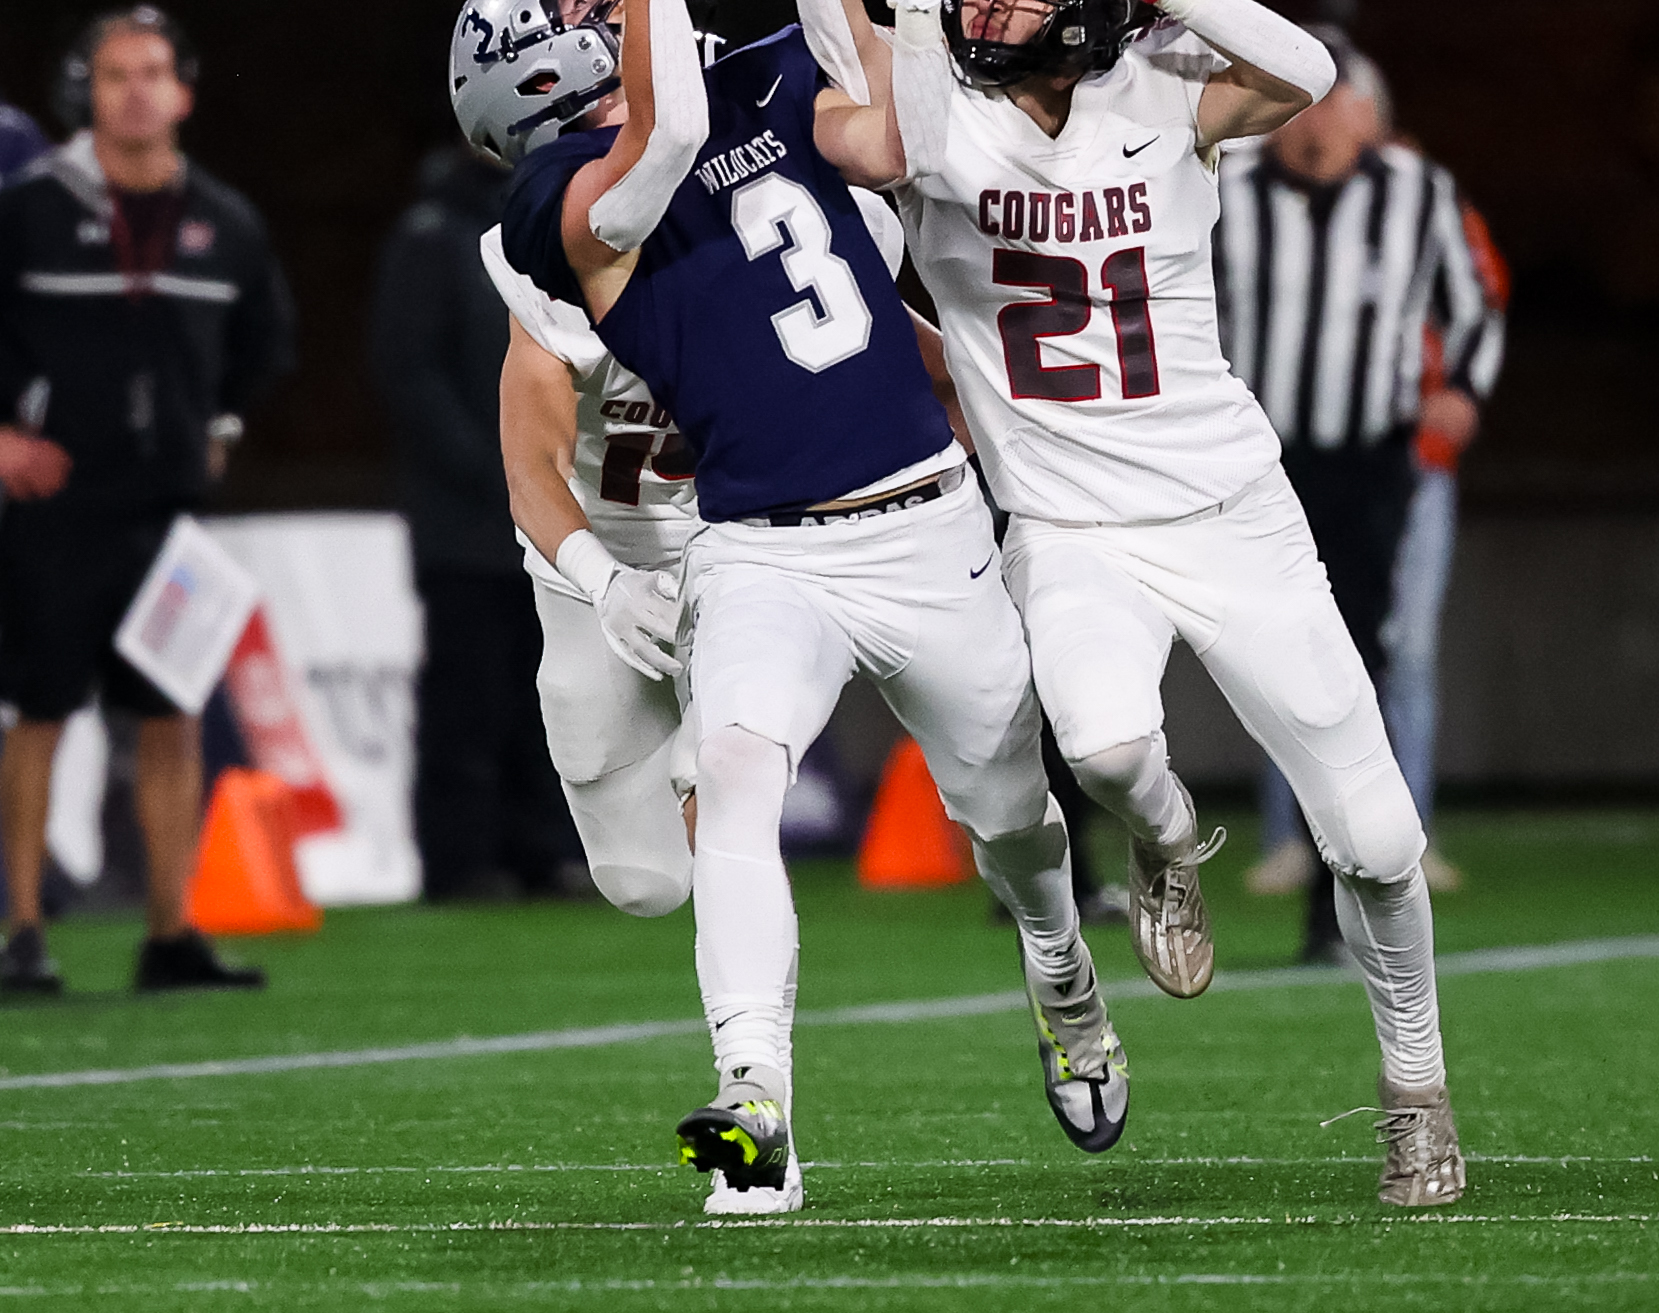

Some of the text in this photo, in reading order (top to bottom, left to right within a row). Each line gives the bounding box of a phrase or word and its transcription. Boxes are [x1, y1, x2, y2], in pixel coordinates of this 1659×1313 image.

[461, 7, 501, 63] 3
[694, 129, 787, 195] WILDCATS
[978, 182, 1152, 243] COUGARS
[731, 171, 873, 374] 3
[993, 246, 1160, 401] 21
